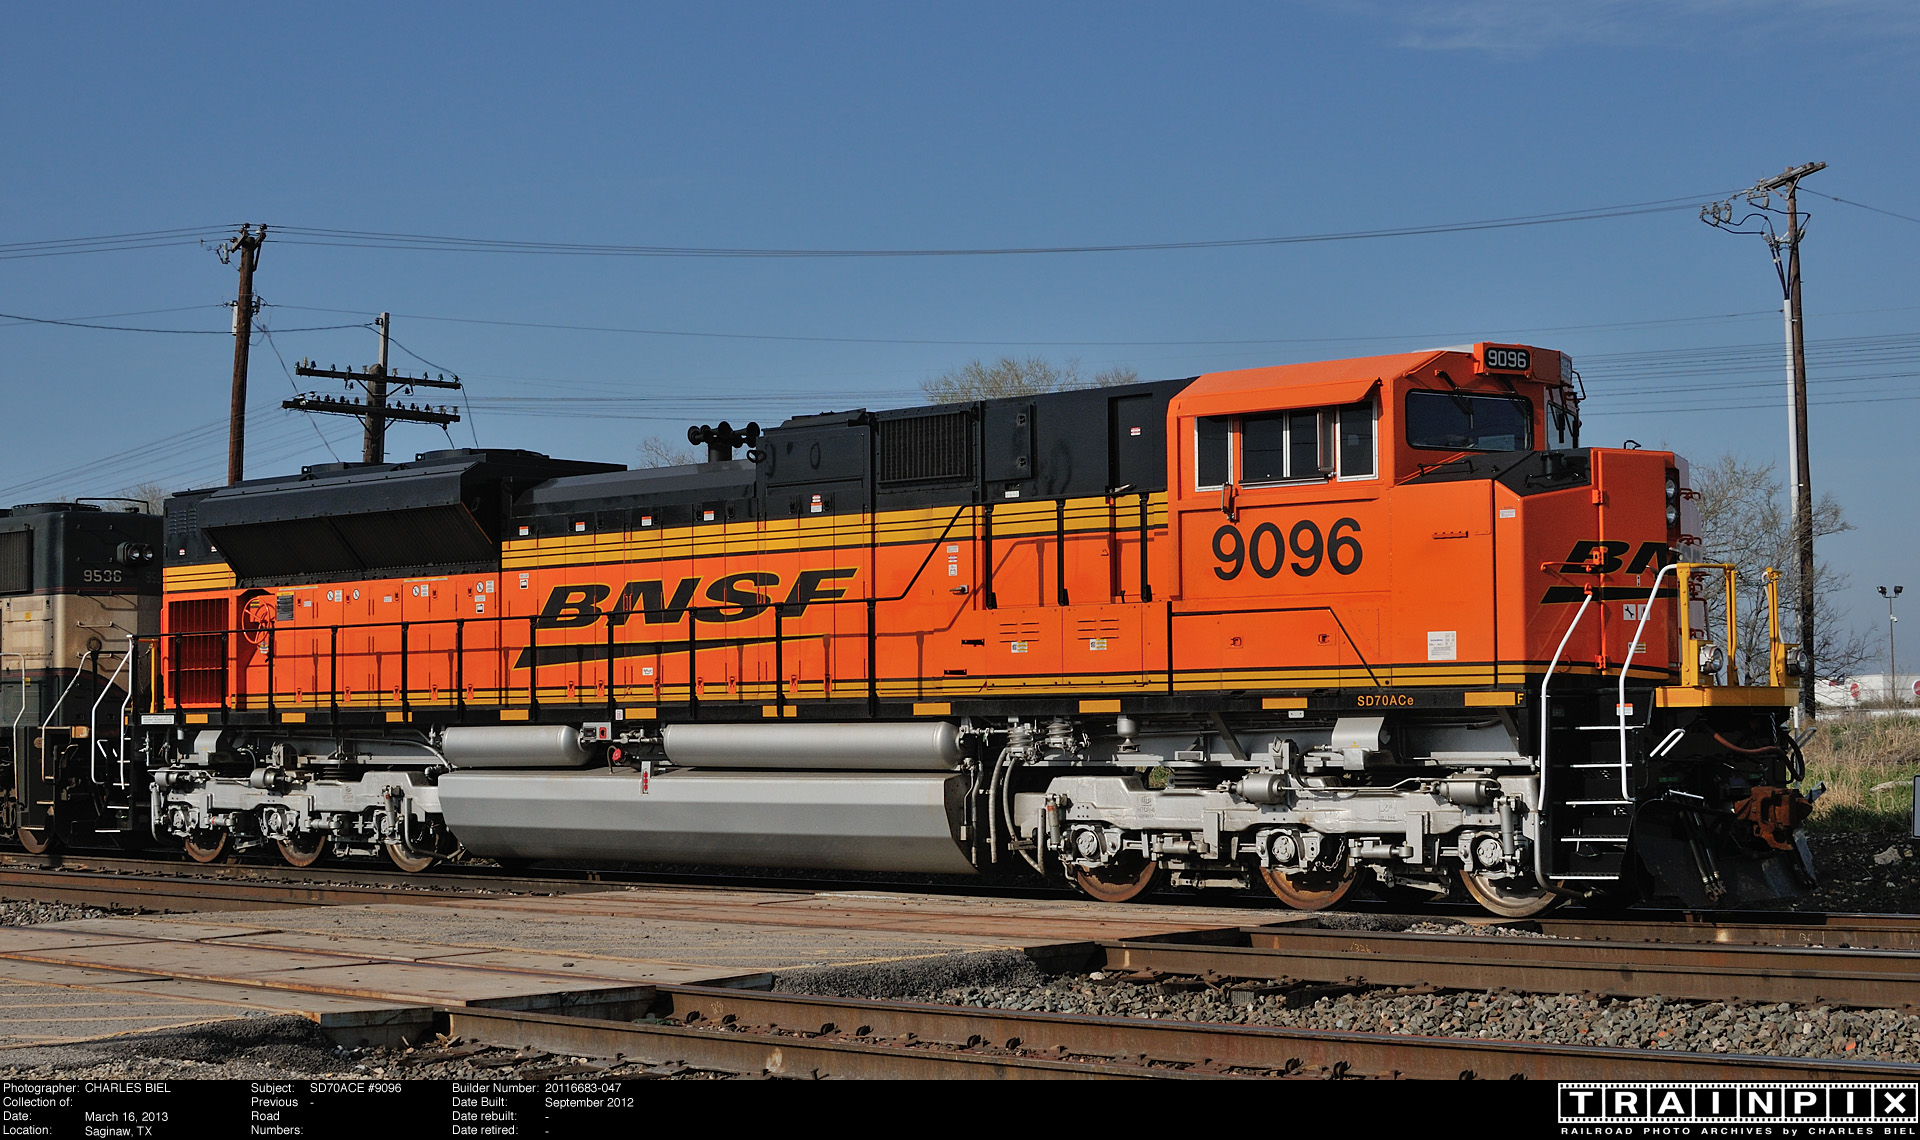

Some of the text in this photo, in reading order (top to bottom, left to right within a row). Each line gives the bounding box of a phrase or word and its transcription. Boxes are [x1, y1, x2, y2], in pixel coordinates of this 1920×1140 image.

[1488, 349, 1527, 368] 9096
[1211, 517, 1363, 581] 9096
[83, 569, 122, 583] 9536
[533, 566, 861, 630] BNSF
[1357, 694, 1414, 707] SD70ACe
[1517, 693, 1525, 705] F
